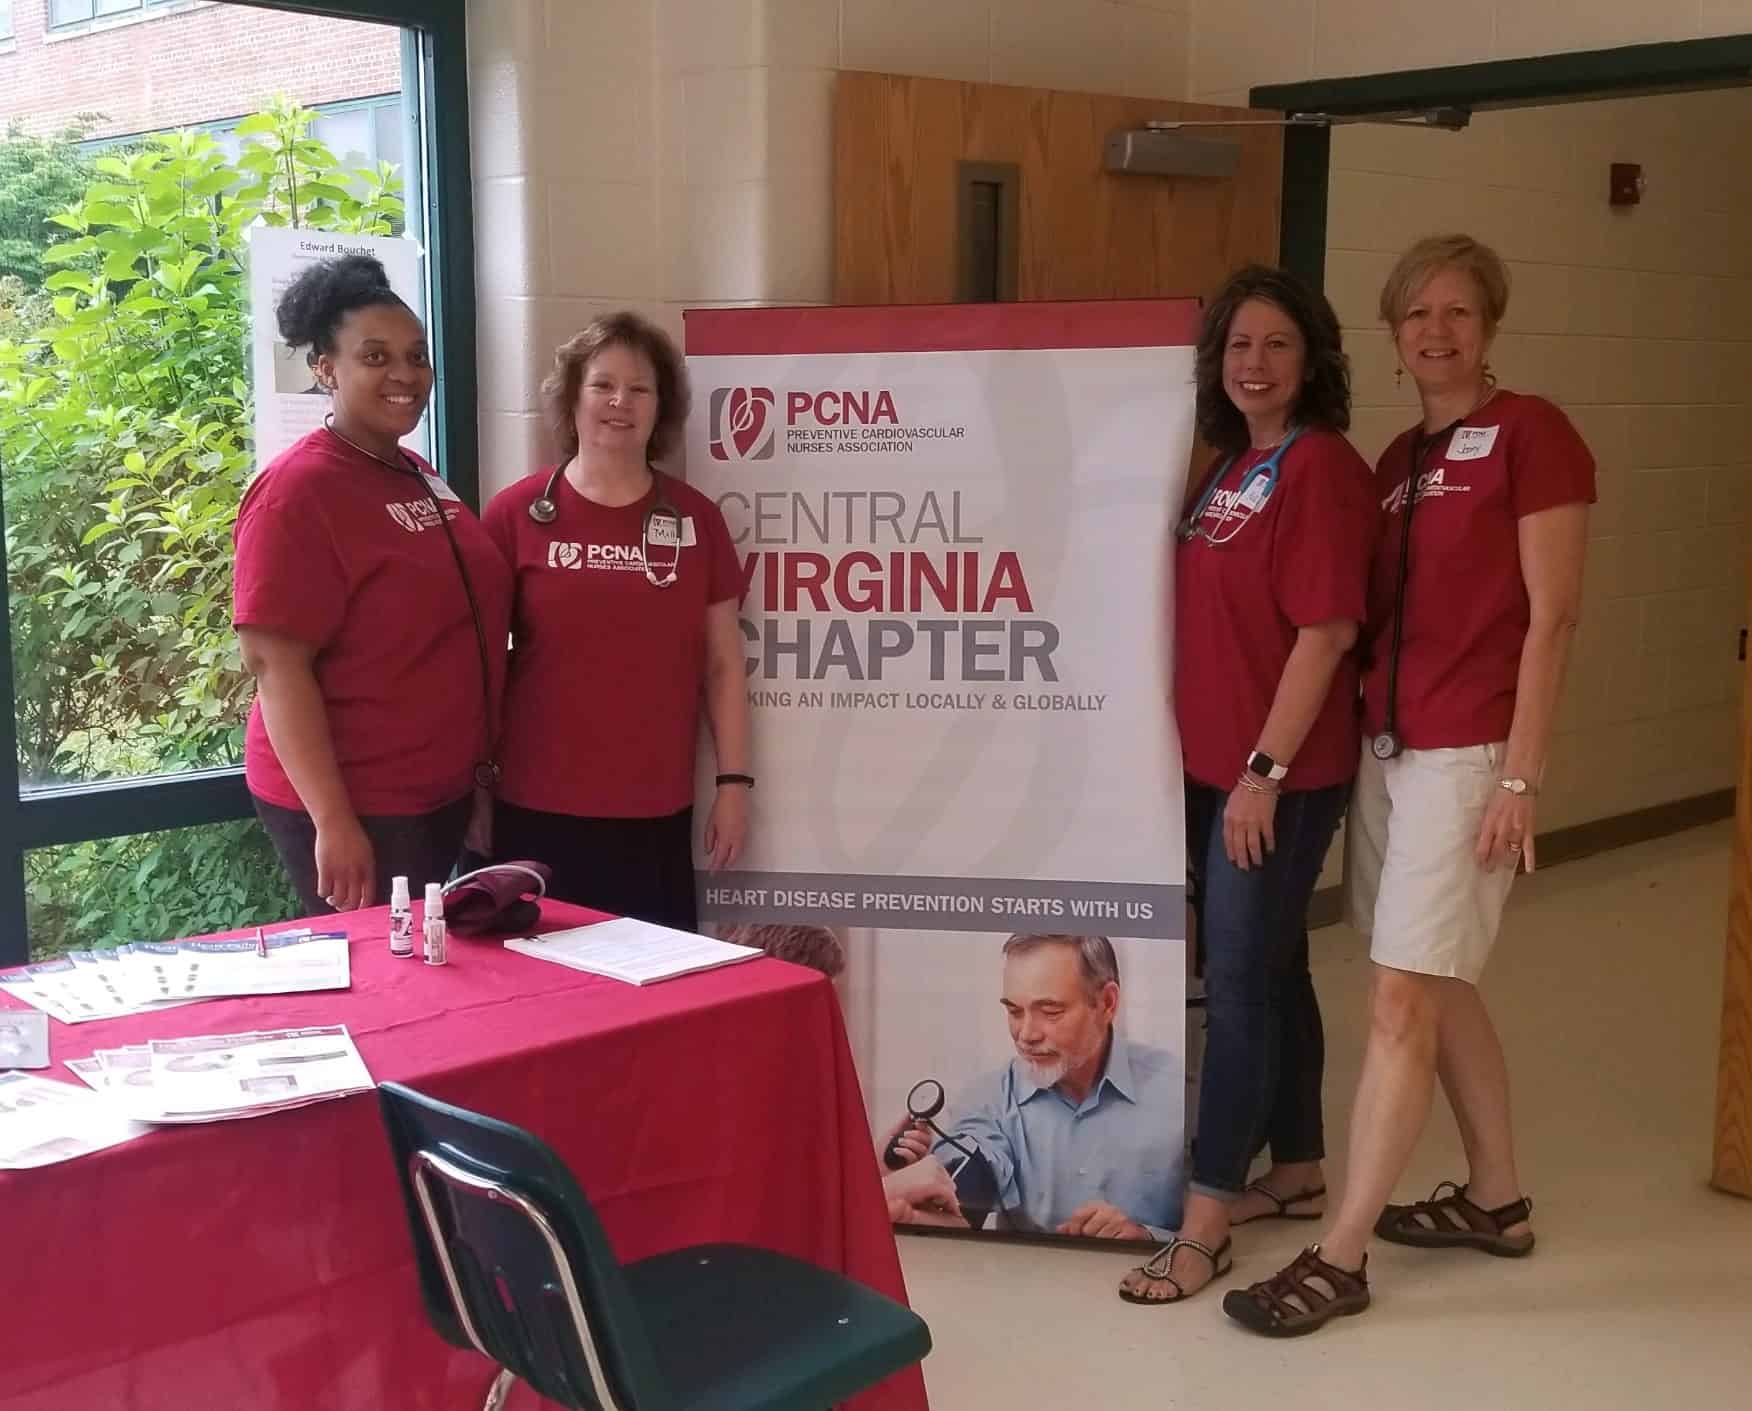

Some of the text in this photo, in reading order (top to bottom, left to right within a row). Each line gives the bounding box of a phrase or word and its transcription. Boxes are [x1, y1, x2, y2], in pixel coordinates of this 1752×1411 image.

[299, 240, 376, 257] Edward Bouchet
[786, 390, 899, 426] PCNA
[786, 426, 965, 441] PREVENTIVE CARDIOVASCULAR
[786, 440, 913, 454] NURSES ASSOCIATION
[716, 490, 984, 545] CENTRAL
[587, 544, 643, 561] PCNA
[797, 691, 823, 708] AN
[830, 692, 900, 710] IMPACT
[906, 692, 986, 710] LOCALLY
[991, 693, 1007, 710] &
[1012, 693, 1107, 712] GLOBALLY
[705, 888, 1154, 920] HEART DISEASE PREVENTION STARTS WITH US
